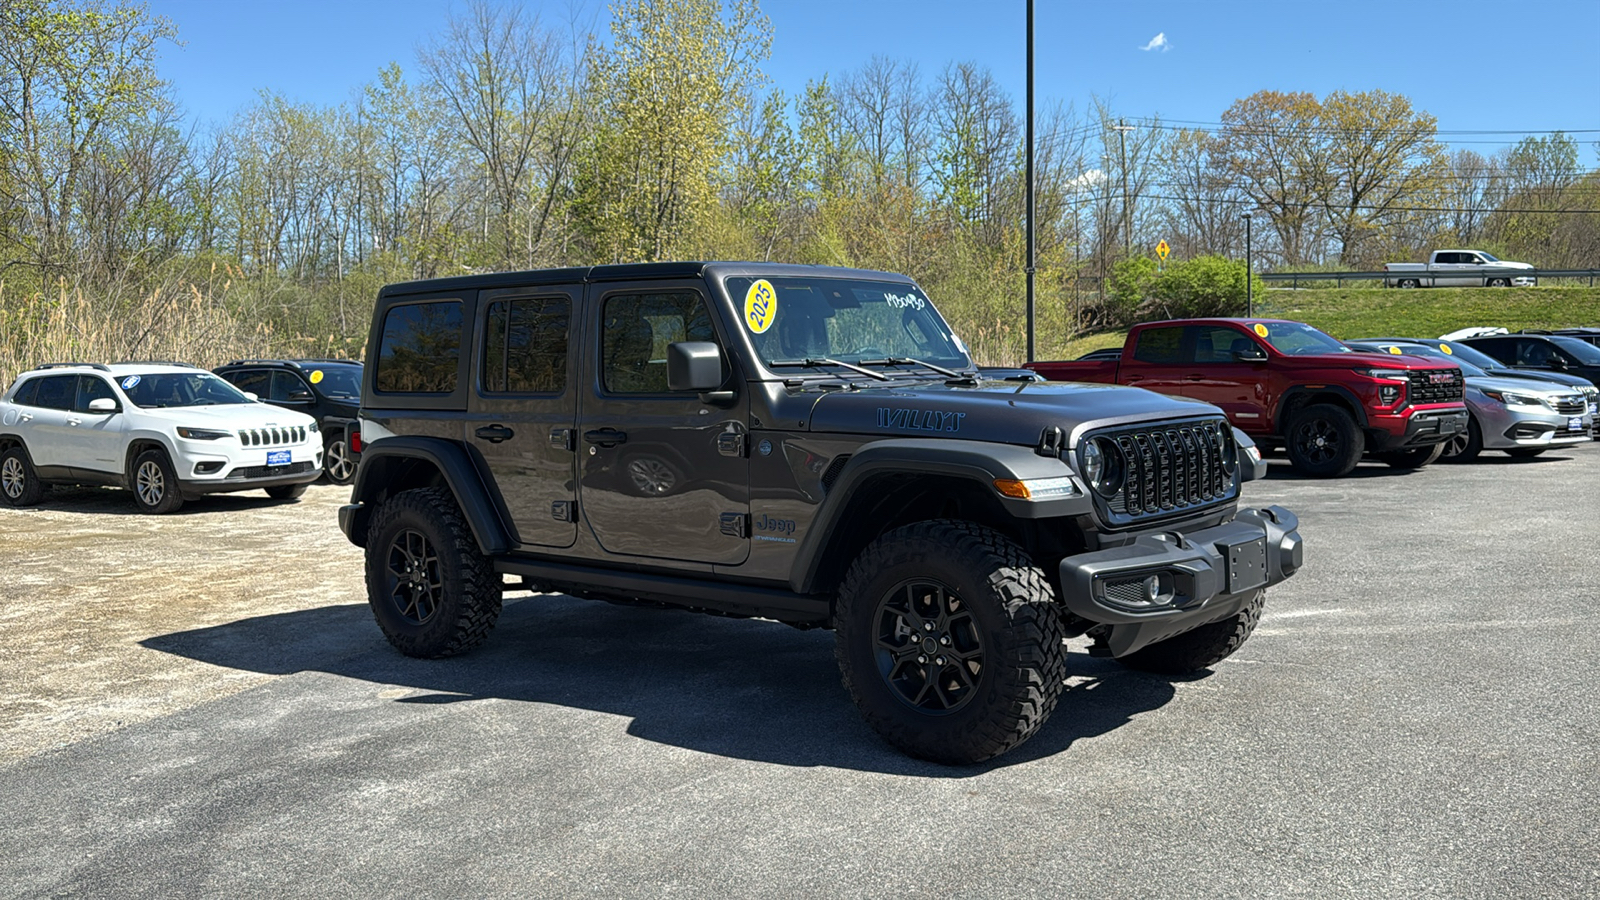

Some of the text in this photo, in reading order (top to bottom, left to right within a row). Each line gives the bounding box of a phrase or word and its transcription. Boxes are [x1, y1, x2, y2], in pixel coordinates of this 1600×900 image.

[750, 283, 771, 329] 2025
[877, 407, 966, 432] WILLYS
[756, 513, 797, 536] Jeep
